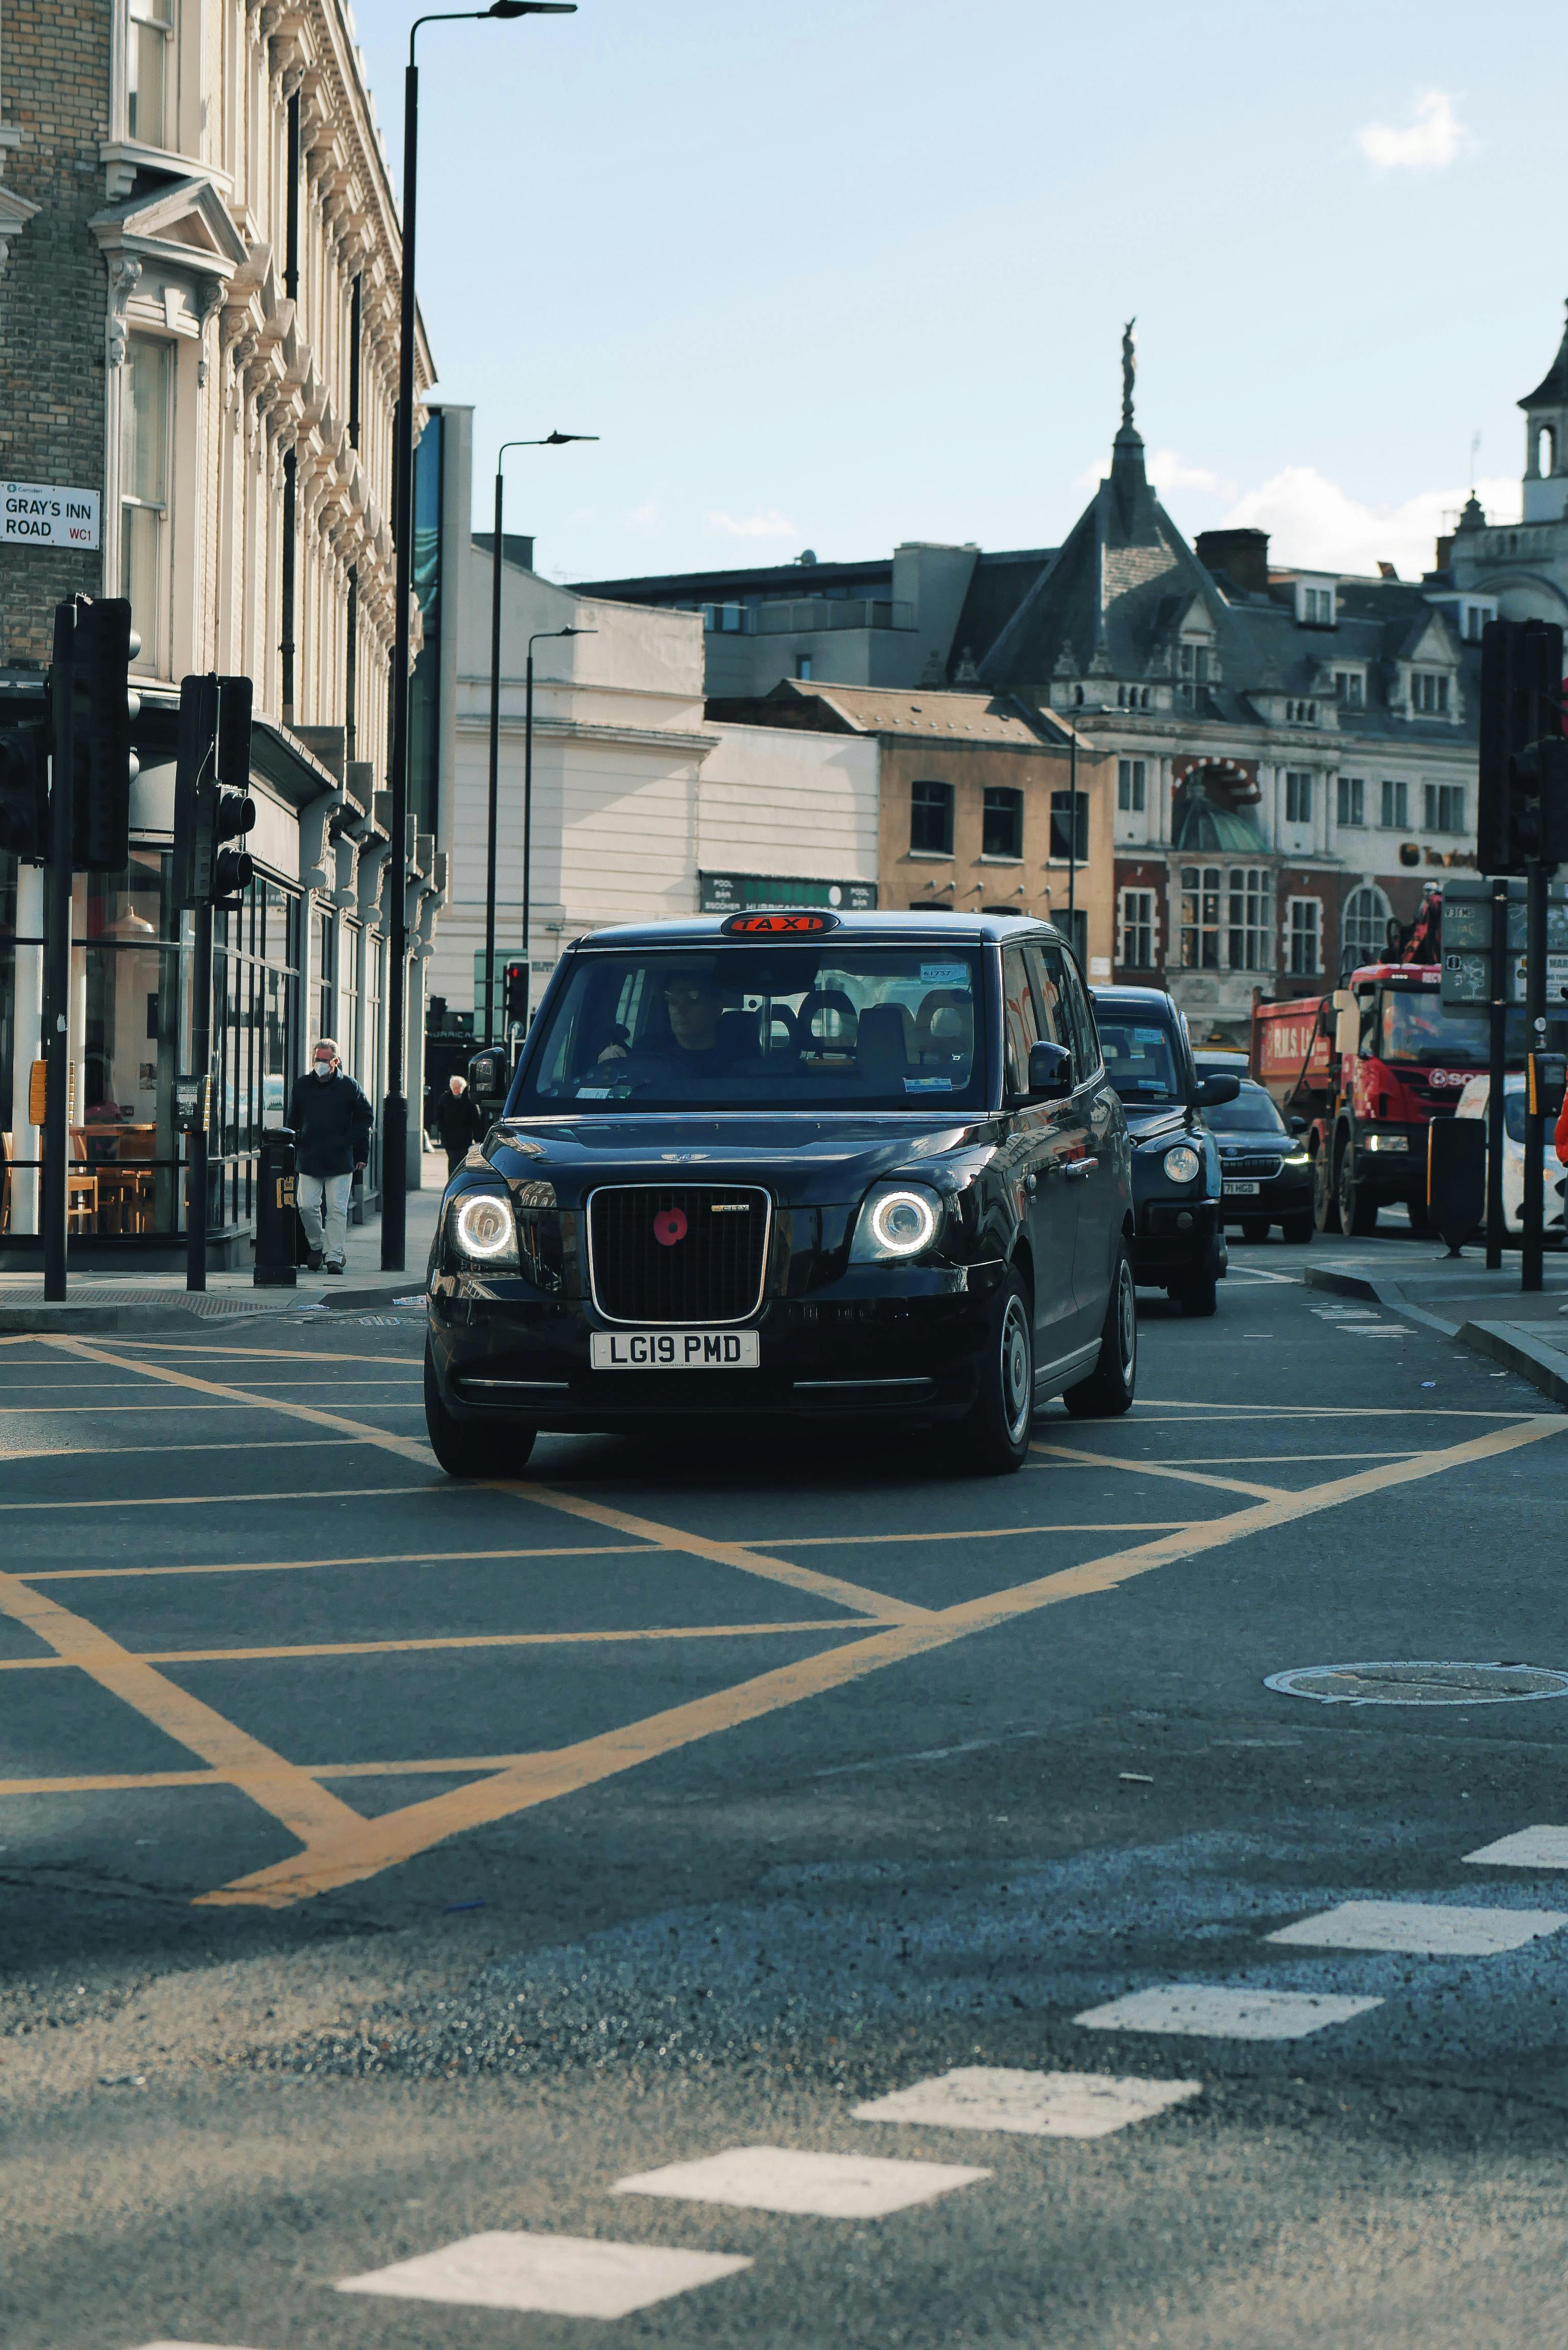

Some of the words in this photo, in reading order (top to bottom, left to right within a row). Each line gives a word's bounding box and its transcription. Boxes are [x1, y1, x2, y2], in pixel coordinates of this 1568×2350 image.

[6, 498, 61, 517] GRAY'S
[66, 503, 91, 520] INN
[6, 518, 52, 536] ROAD
[69, 528, 91, 541] WC1
[713, 879, 733, 888] POOL
[850, 888, 870, 896] POOL
[852, 899, 868, 907] BAR
[741, 918, 815, 930] TAXI
[610, 1336, 675, 1363] LG19
[684, 1335, 741, 1362] PMD
